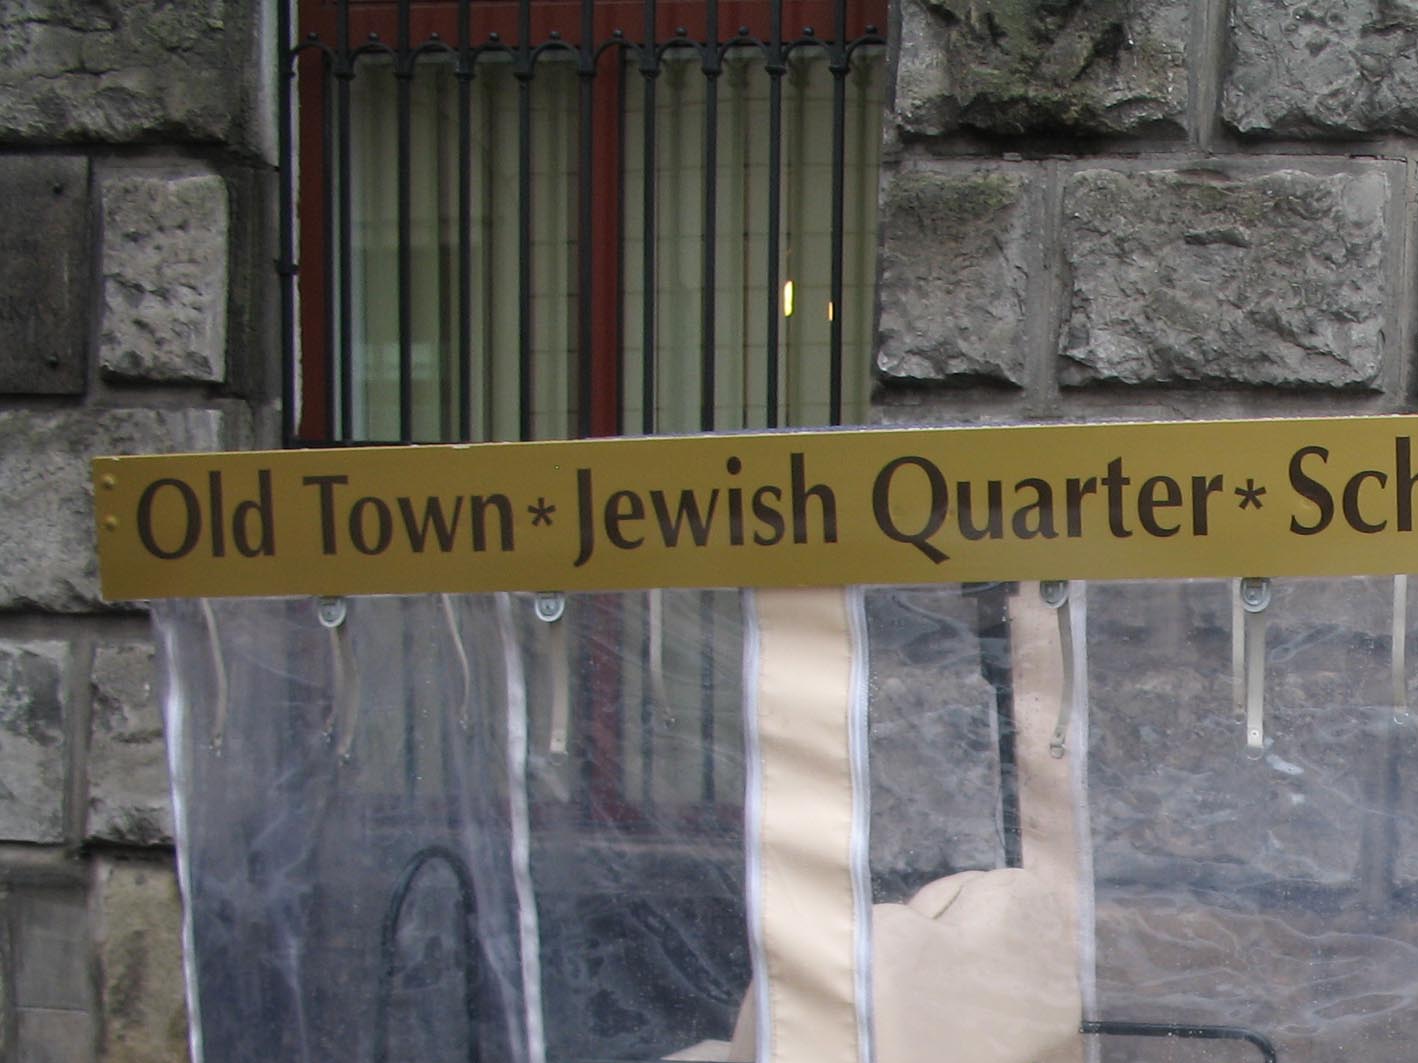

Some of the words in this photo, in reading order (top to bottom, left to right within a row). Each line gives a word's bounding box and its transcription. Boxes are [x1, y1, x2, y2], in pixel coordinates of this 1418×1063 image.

[136, 468, 276, 561] Old
[302, 474, 515, 556] Town
[572, 452, 838, 568] Jewish
[871, 455, 1224, 565] Quarter
